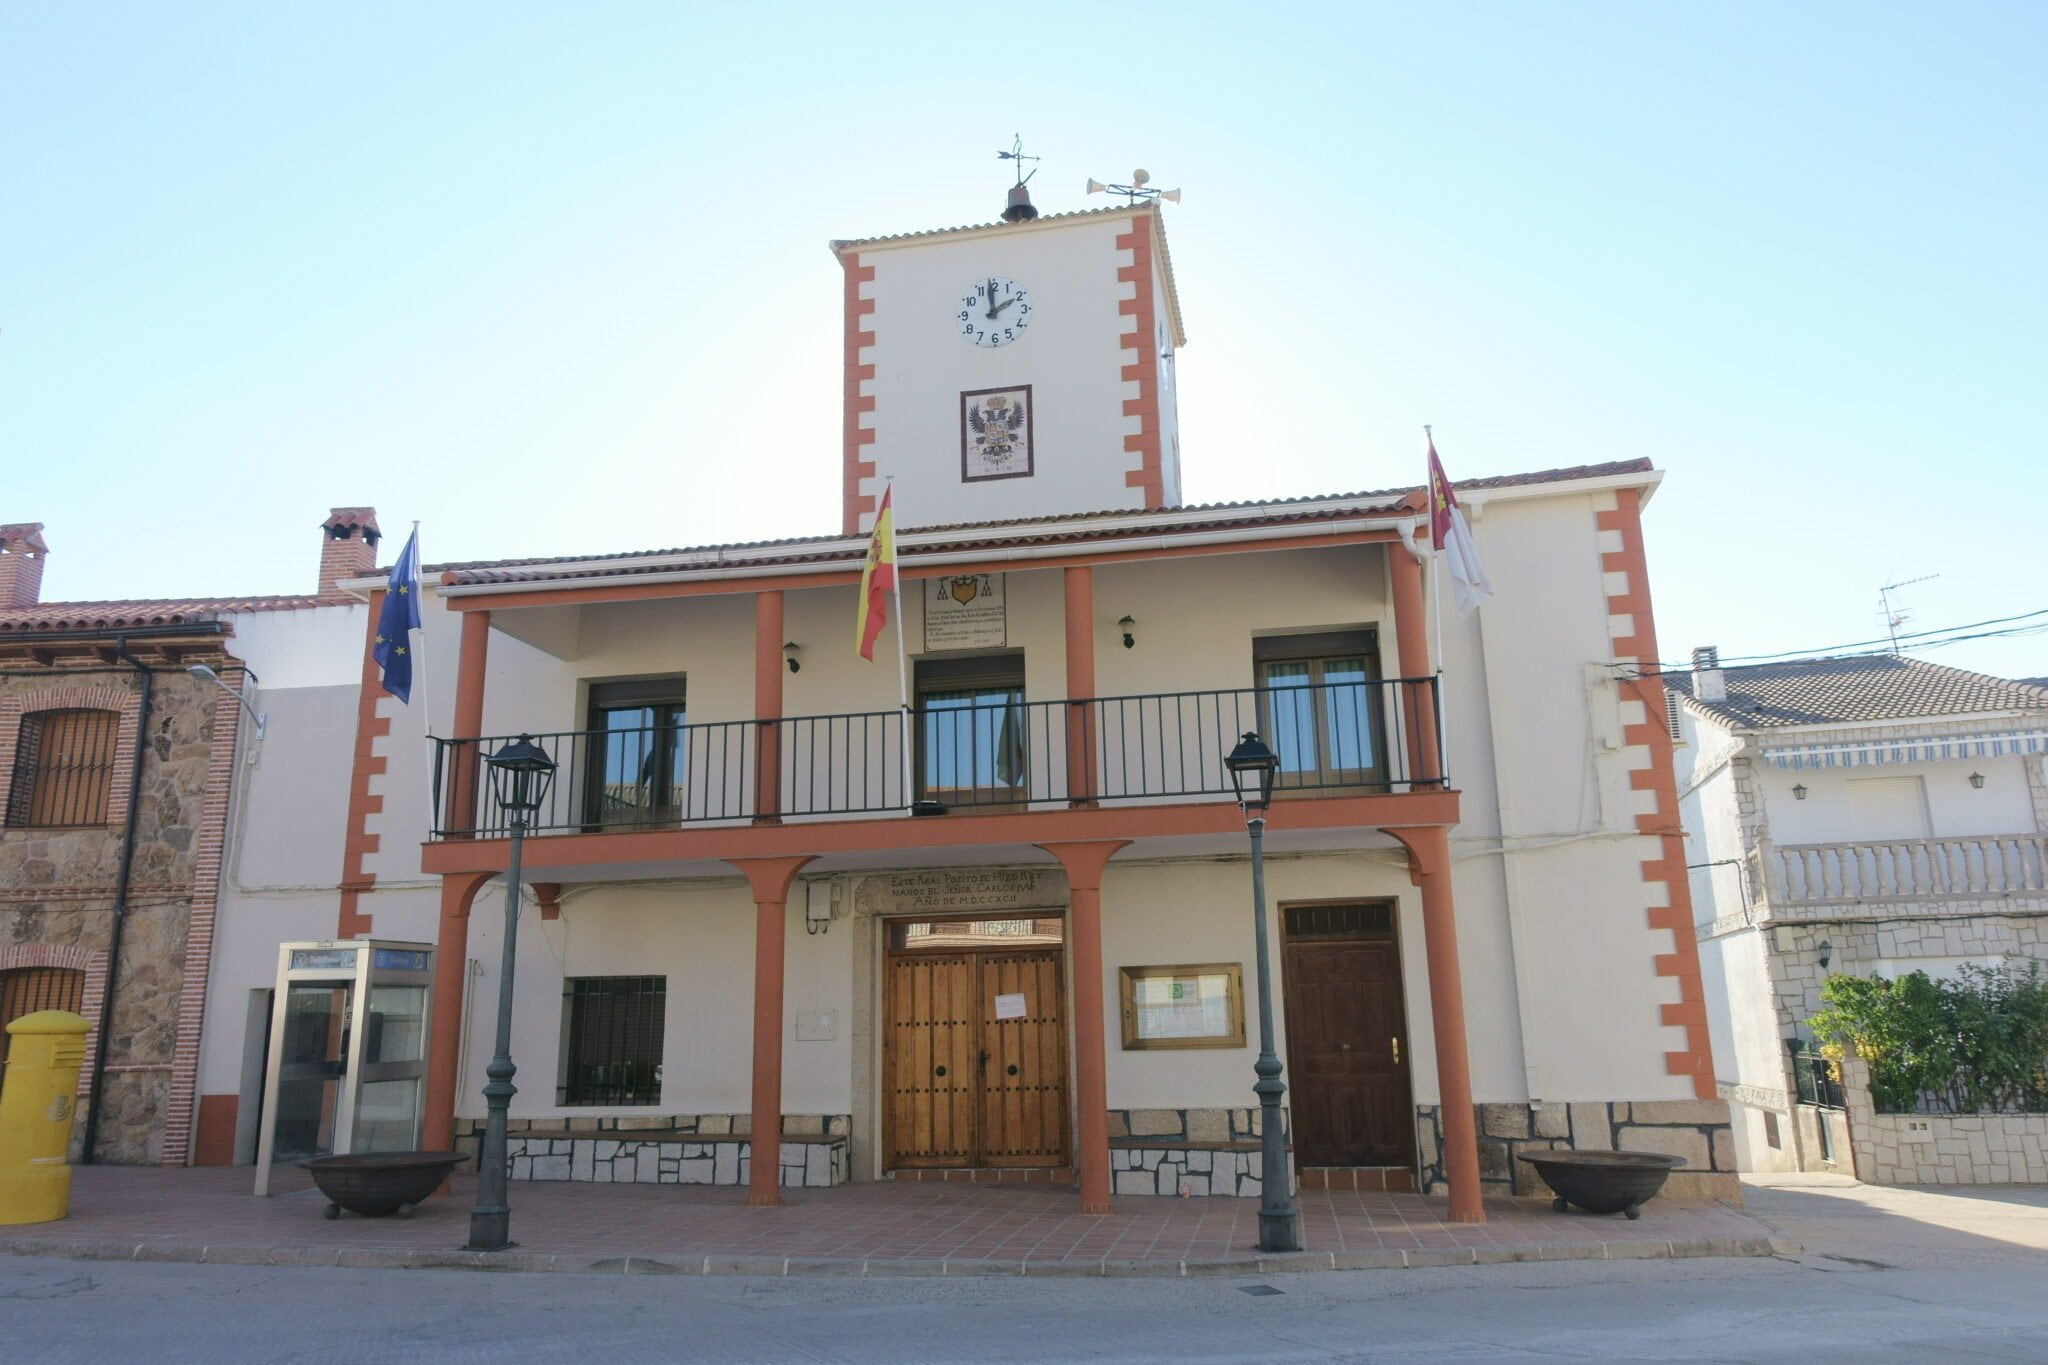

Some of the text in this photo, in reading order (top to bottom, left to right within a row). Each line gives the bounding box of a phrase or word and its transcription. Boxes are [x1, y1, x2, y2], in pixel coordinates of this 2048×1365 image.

[978, 286, 985, 297] 11
[1005, 283, 1009, 294] 1
[1016, 291, 1023, 301] 2
[966, 296, 976, 307] 10
[1020, 304, 1028, 314] 3
[961, 311, 969, 321] 9
[1016, 318, 1024, 328] 4
[966, 324, 973, 334] 8
[1004, 328, 1012, 339] 5
[977, 331, 984, 341] 7
[991, 333, 999, 343] 6
